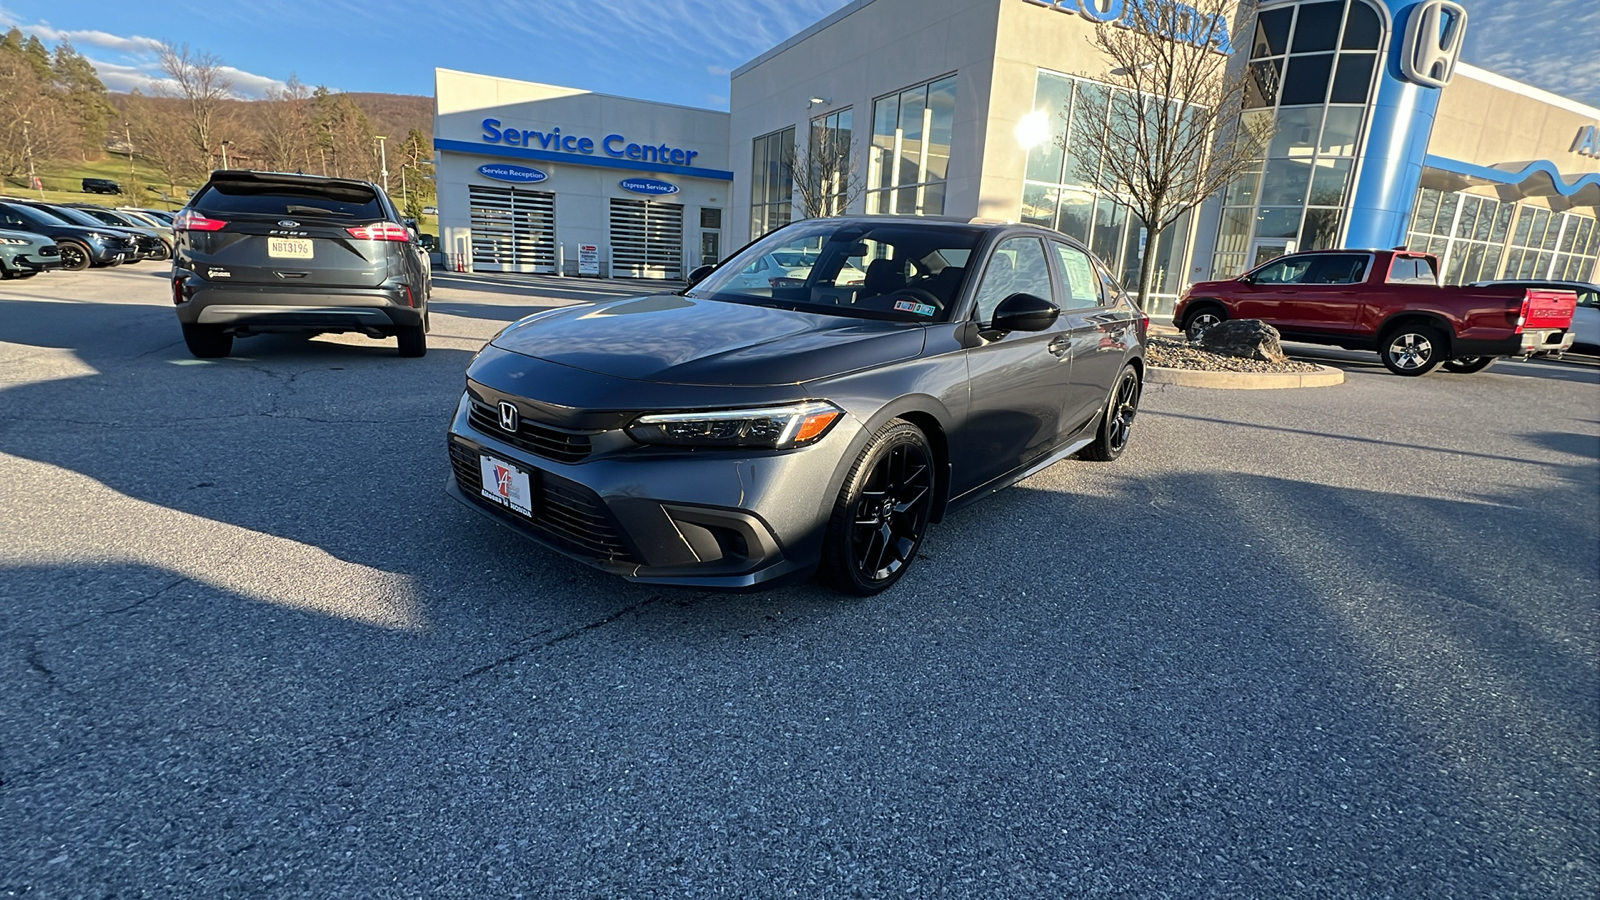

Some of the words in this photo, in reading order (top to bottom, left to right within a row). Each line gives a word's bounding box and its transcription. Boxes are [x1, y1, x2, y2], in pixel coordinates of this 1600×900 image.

[1022, 0, 1236, 55] ONDA
[482, 118, 595, 154] Service
[602, 134, 699, 166] Center
[482, 166, 508, 176] Service
[509, 169, 543, 179] Reception
[622, 181, 645, 190] Express
[646, 183, 668, 192] Service
[272, 242, 309, 254] NBT3196
